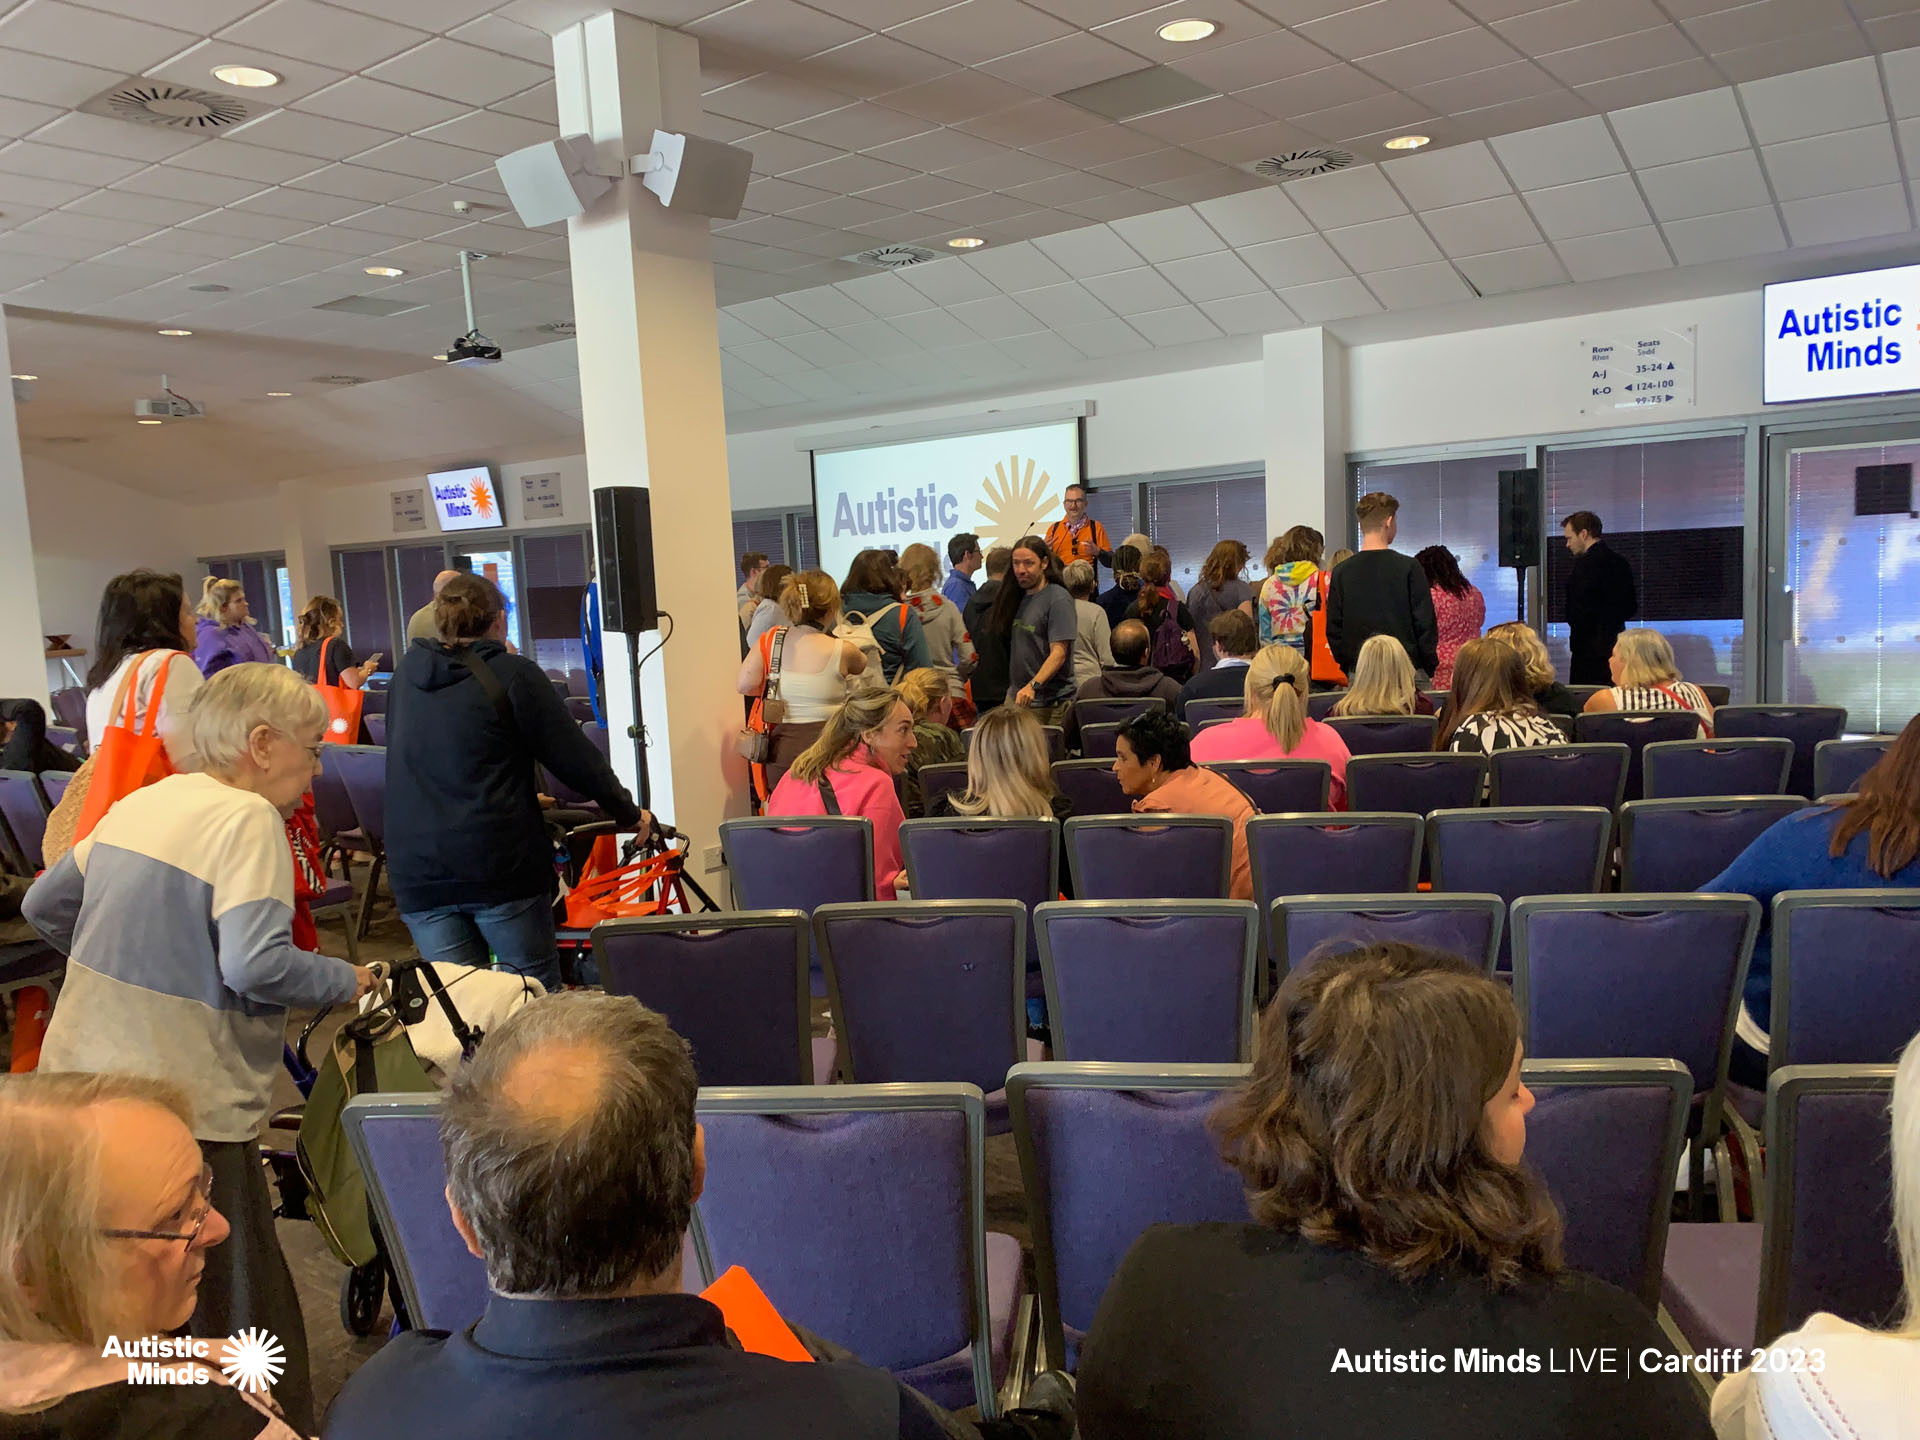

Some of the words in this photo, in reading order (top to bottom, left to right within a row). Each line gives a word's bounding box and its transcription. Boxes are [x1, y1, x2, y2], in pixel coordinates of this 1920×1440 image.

[1778, 298, 1902, 339] Autistic
[1637, 340, 1660, 348] Seats
[1592, 346, 1614, 354] Rows
[1807, 336, 1902, 372] Minds
[1635, 363, 1662, 373] 35-24
[1592, 370, 1607, 379] A-J
[1636, 379, 1674, 391] 124-100
[1592, 386, 1612, 396] K-O
[1635, 395, 1662, 405] 99-75
[435, 484, 467, 501] Autistic
[445, 502, 472, 518] Minds
[832, 483, 959, 538] Autistic
